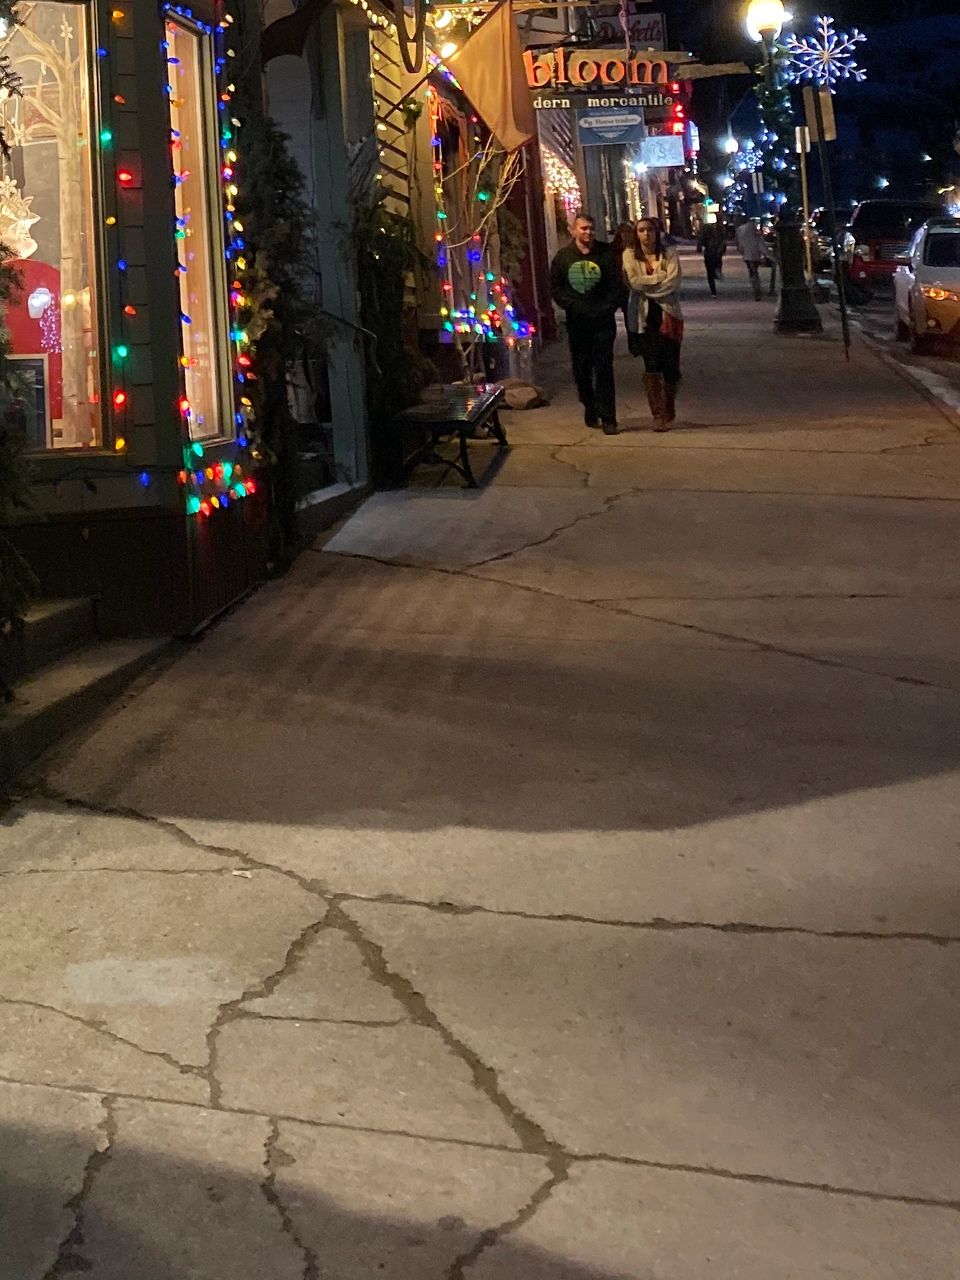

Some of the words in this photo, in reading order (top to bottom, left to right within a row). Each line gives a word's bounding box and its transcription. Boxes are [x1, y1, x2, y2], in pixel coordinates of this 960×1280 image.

[522, 47, 669, 88] bloom
[533, 97, 571, 109] dern
[587, 94, 673, 108] mercantile
